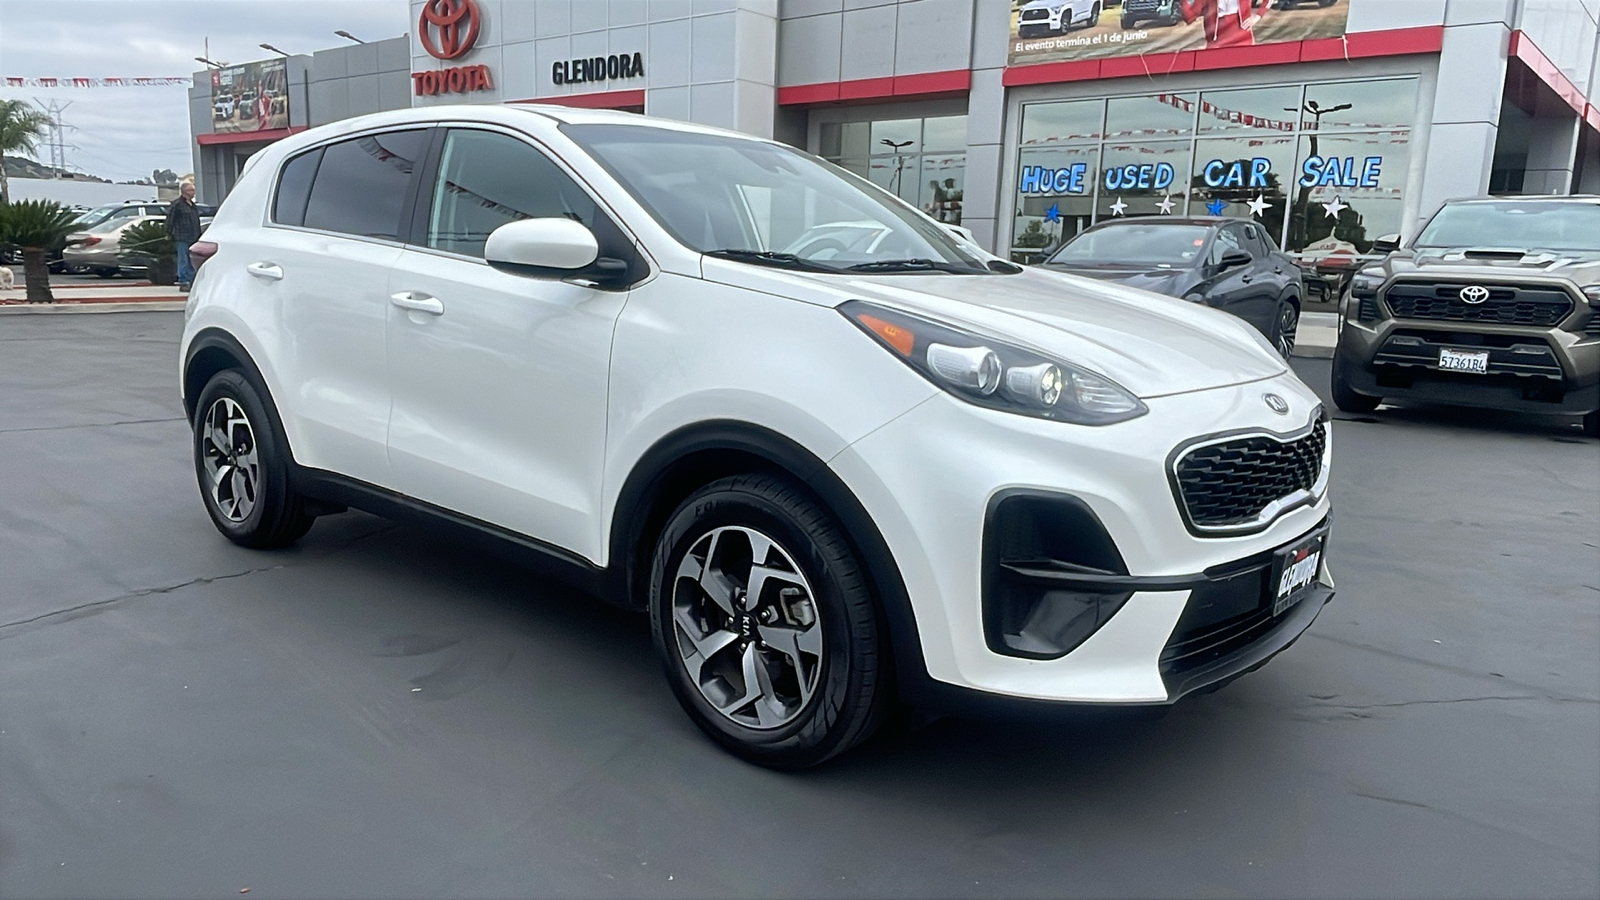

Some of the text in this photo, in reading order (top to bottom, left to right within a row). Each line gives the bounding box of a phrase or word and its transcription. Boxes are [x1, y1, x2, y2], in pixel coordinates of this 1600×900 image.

[1015, 29, 1148, 52] El evento termina el 1 de junio
[411, 64, 495, 97] TOYOTA
[552, 52, 644, 85] GLENDORA
[1021, 155, 1383, 194] HUGE USED CAR SALE
[742, 616, 750, 636] KIA
